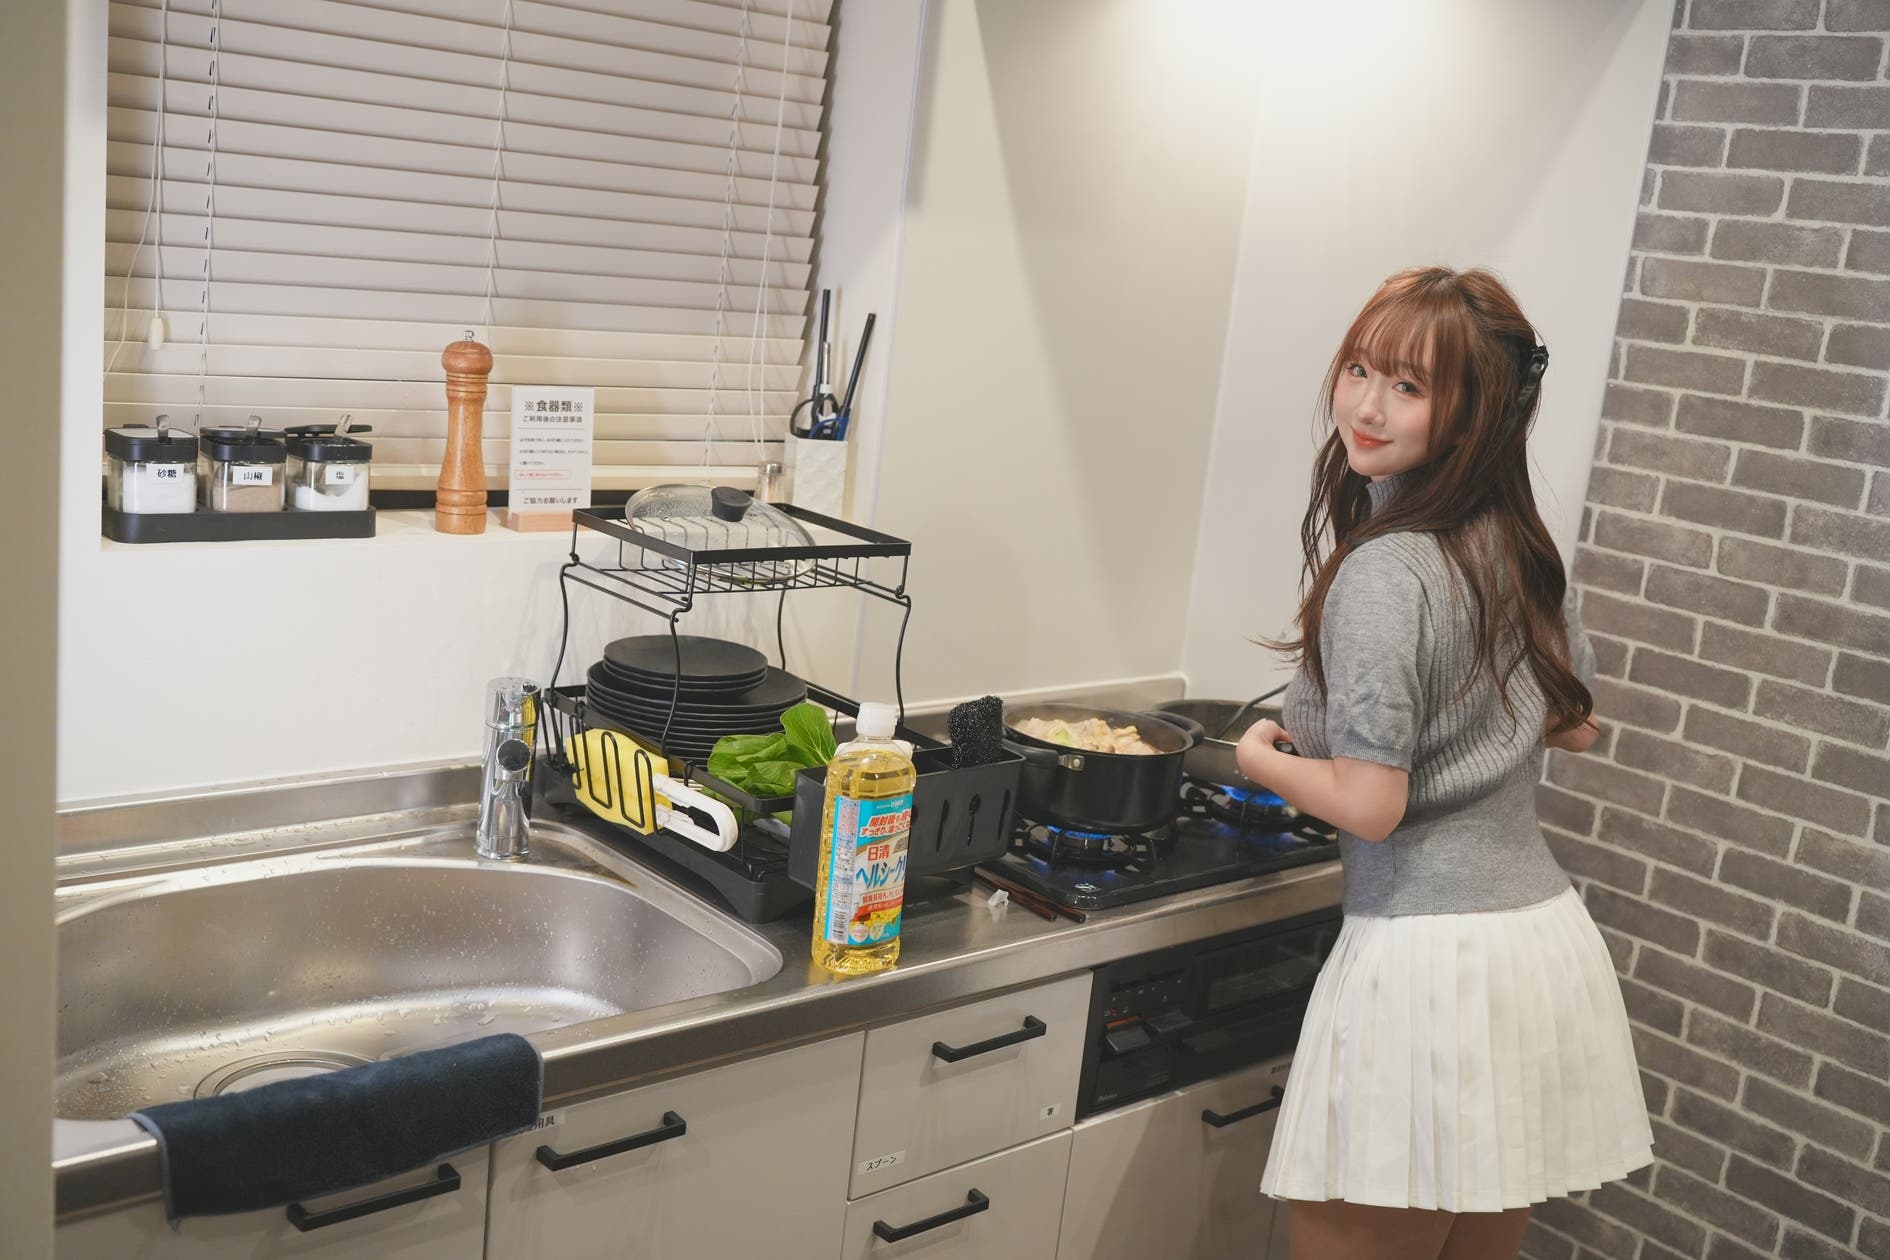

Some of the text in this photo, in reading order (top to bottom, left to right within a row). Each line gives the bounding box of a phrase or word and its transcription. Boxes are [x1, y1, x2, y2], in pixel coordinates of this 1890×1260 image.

[157, 468, 177, 479] 砂糖
[523, 496, 578, 505] ご協力お願いします
[867, 844, 890, 862] 日清
[865, 1155, 897, 1171] スプーン
